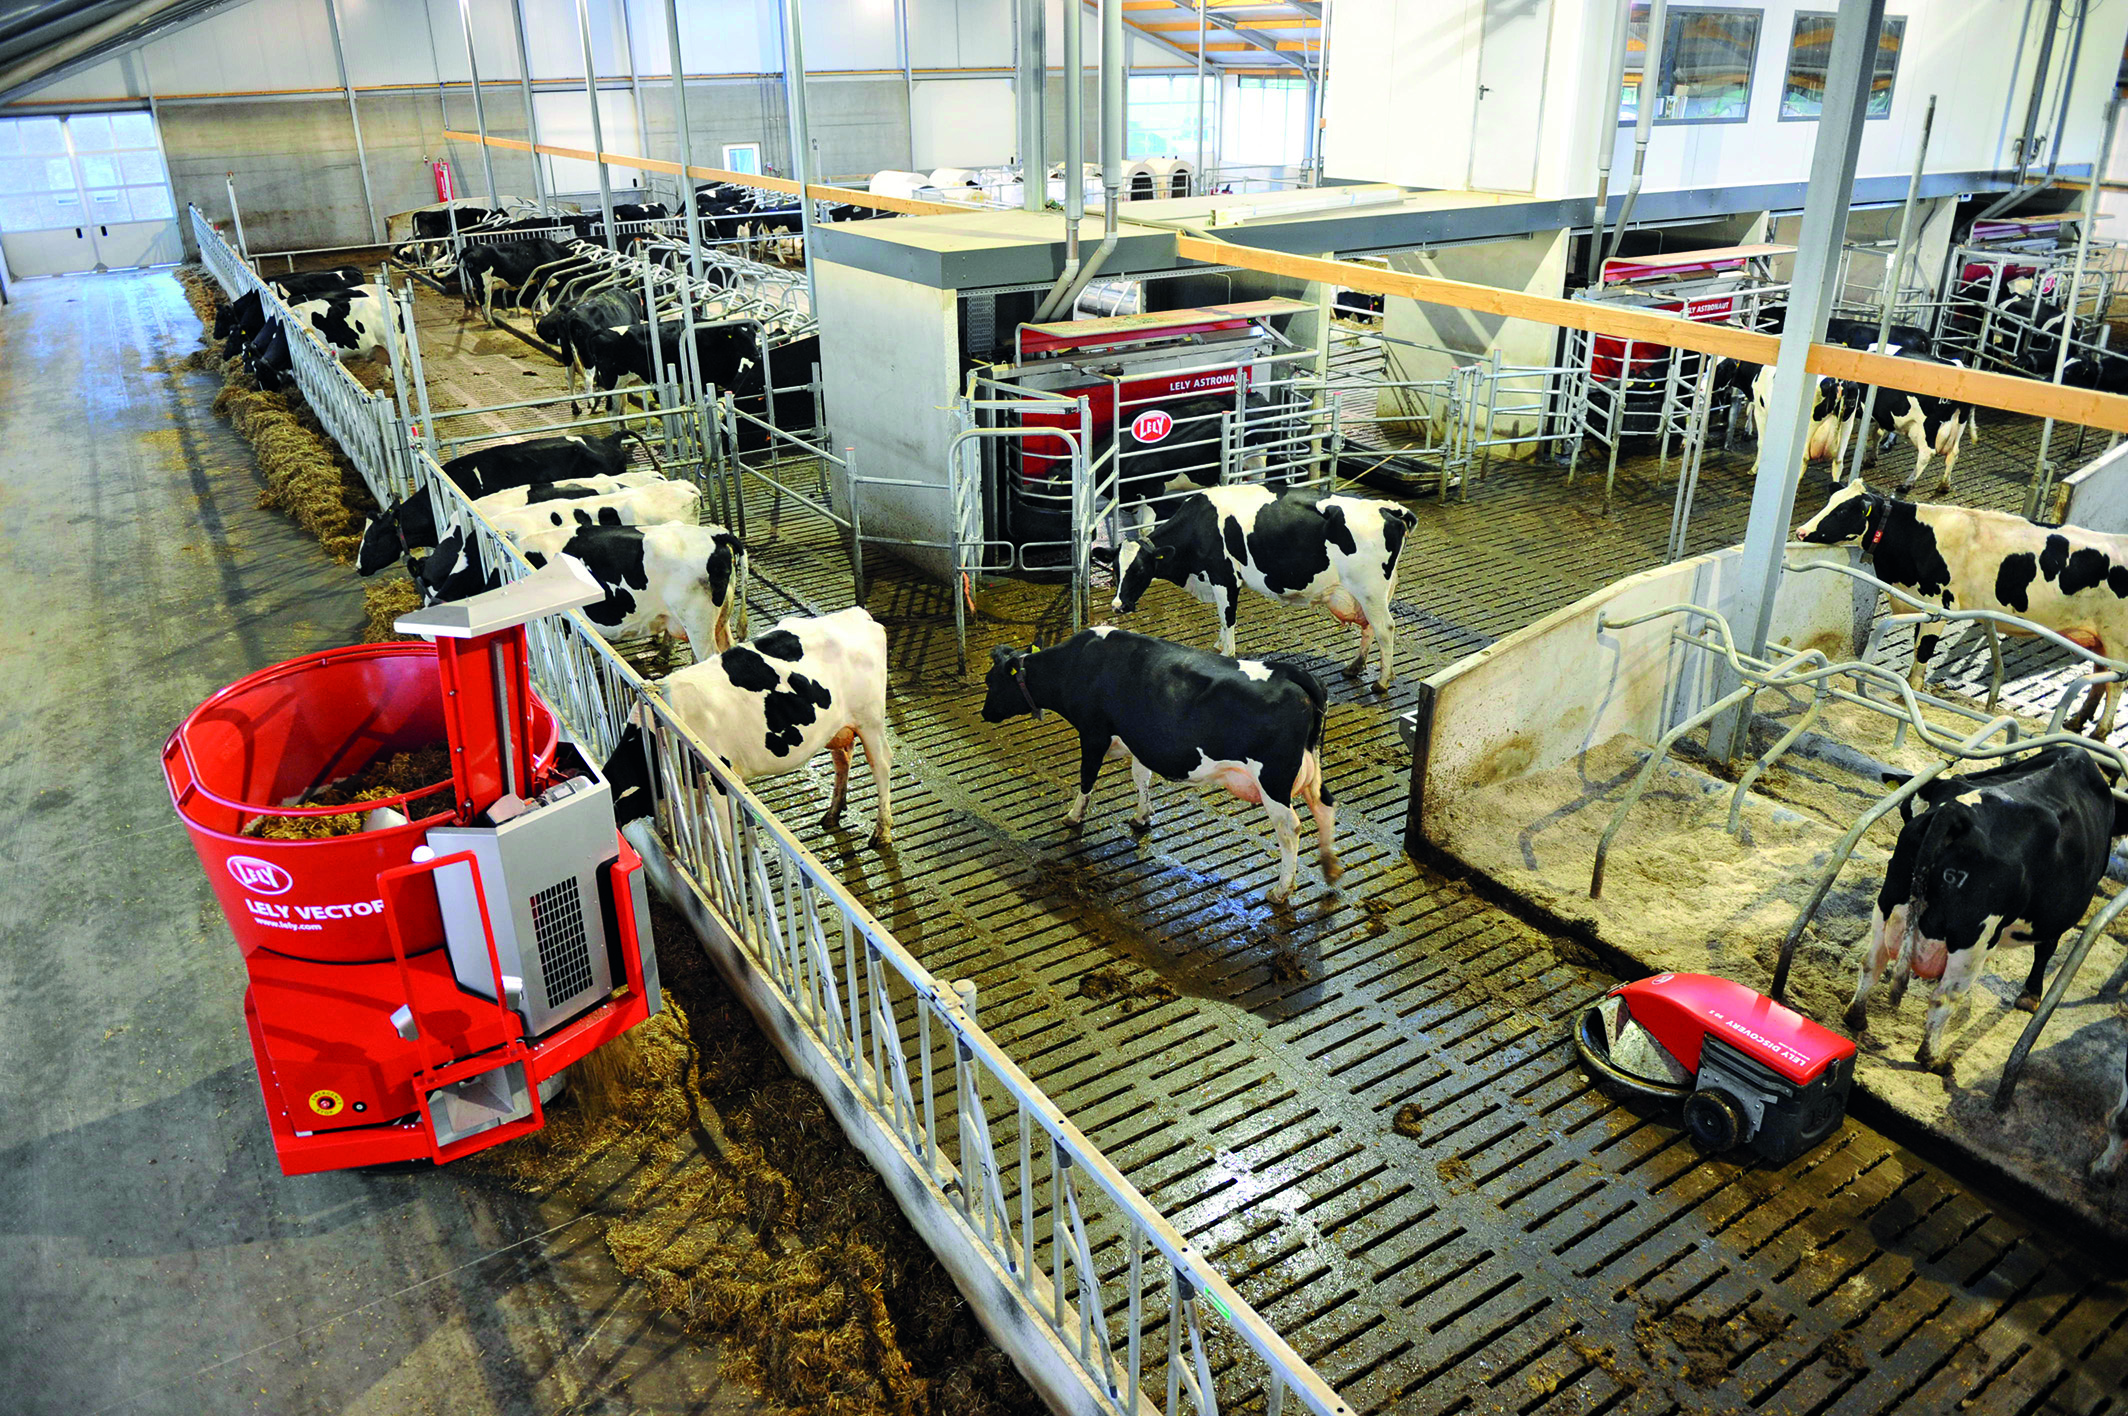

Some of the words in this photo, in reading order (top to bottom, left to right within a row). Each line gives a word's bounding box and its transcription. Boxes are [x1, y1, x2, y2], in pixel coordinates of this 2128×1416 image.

[1696, 302, 1729, 313] ASTRONAUT
[1170, 380, 1191, 392] LELY
[1139, 416, 1165, 439] LELY
[234, 862, 280, 889] LELY
[1943, 868, 1969, 889] 67
[245, 898, 290, 920] LELY
[254, 917, 323, 932] www.lely.com
[1725, 1020, 1782, 1053] DISCOVERY
[1781, 1051, 1807, 1067] LELY
